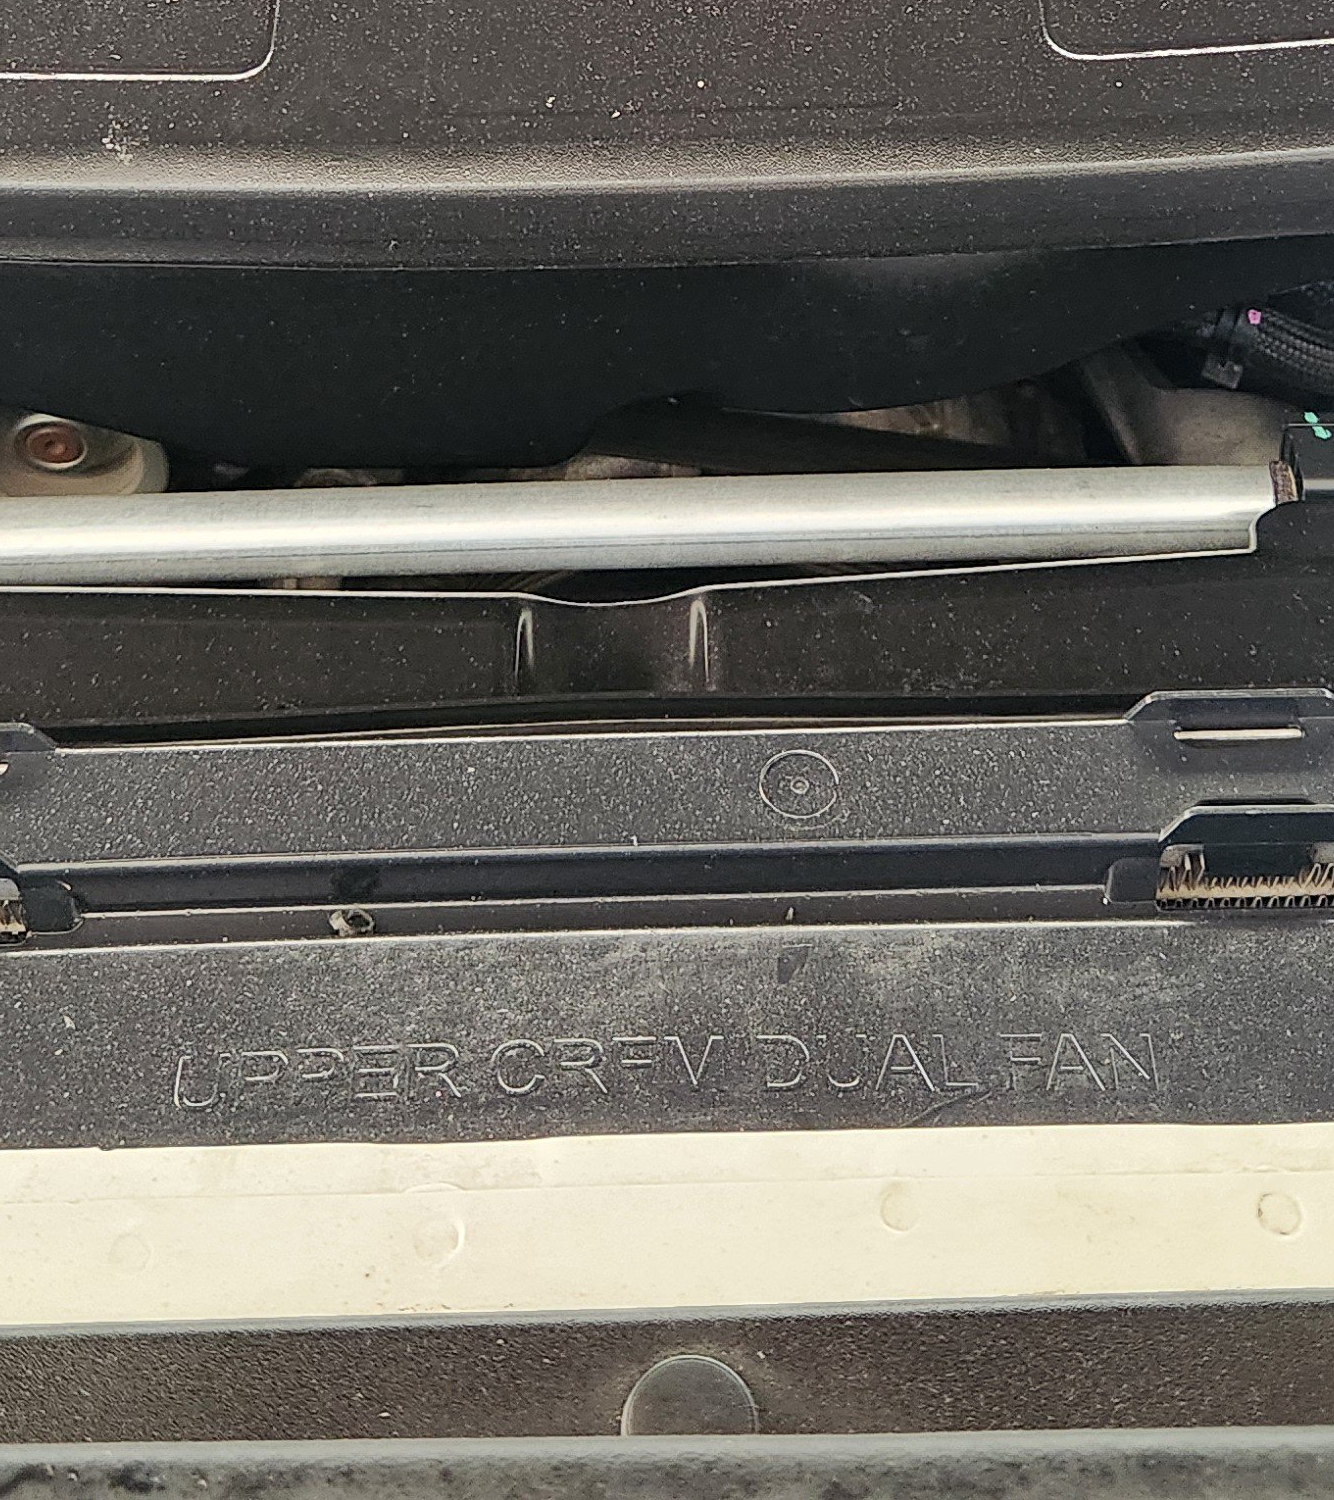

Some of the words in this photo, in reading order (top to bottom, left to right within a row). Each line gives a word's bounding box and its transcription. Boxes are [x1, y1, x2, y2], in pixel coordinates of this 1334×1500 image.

[172, 1042, 463, 1109] UPPER
[755, 1032, 980, 1093] DUAL
[999, 1031, 1161, 1093] FAN
